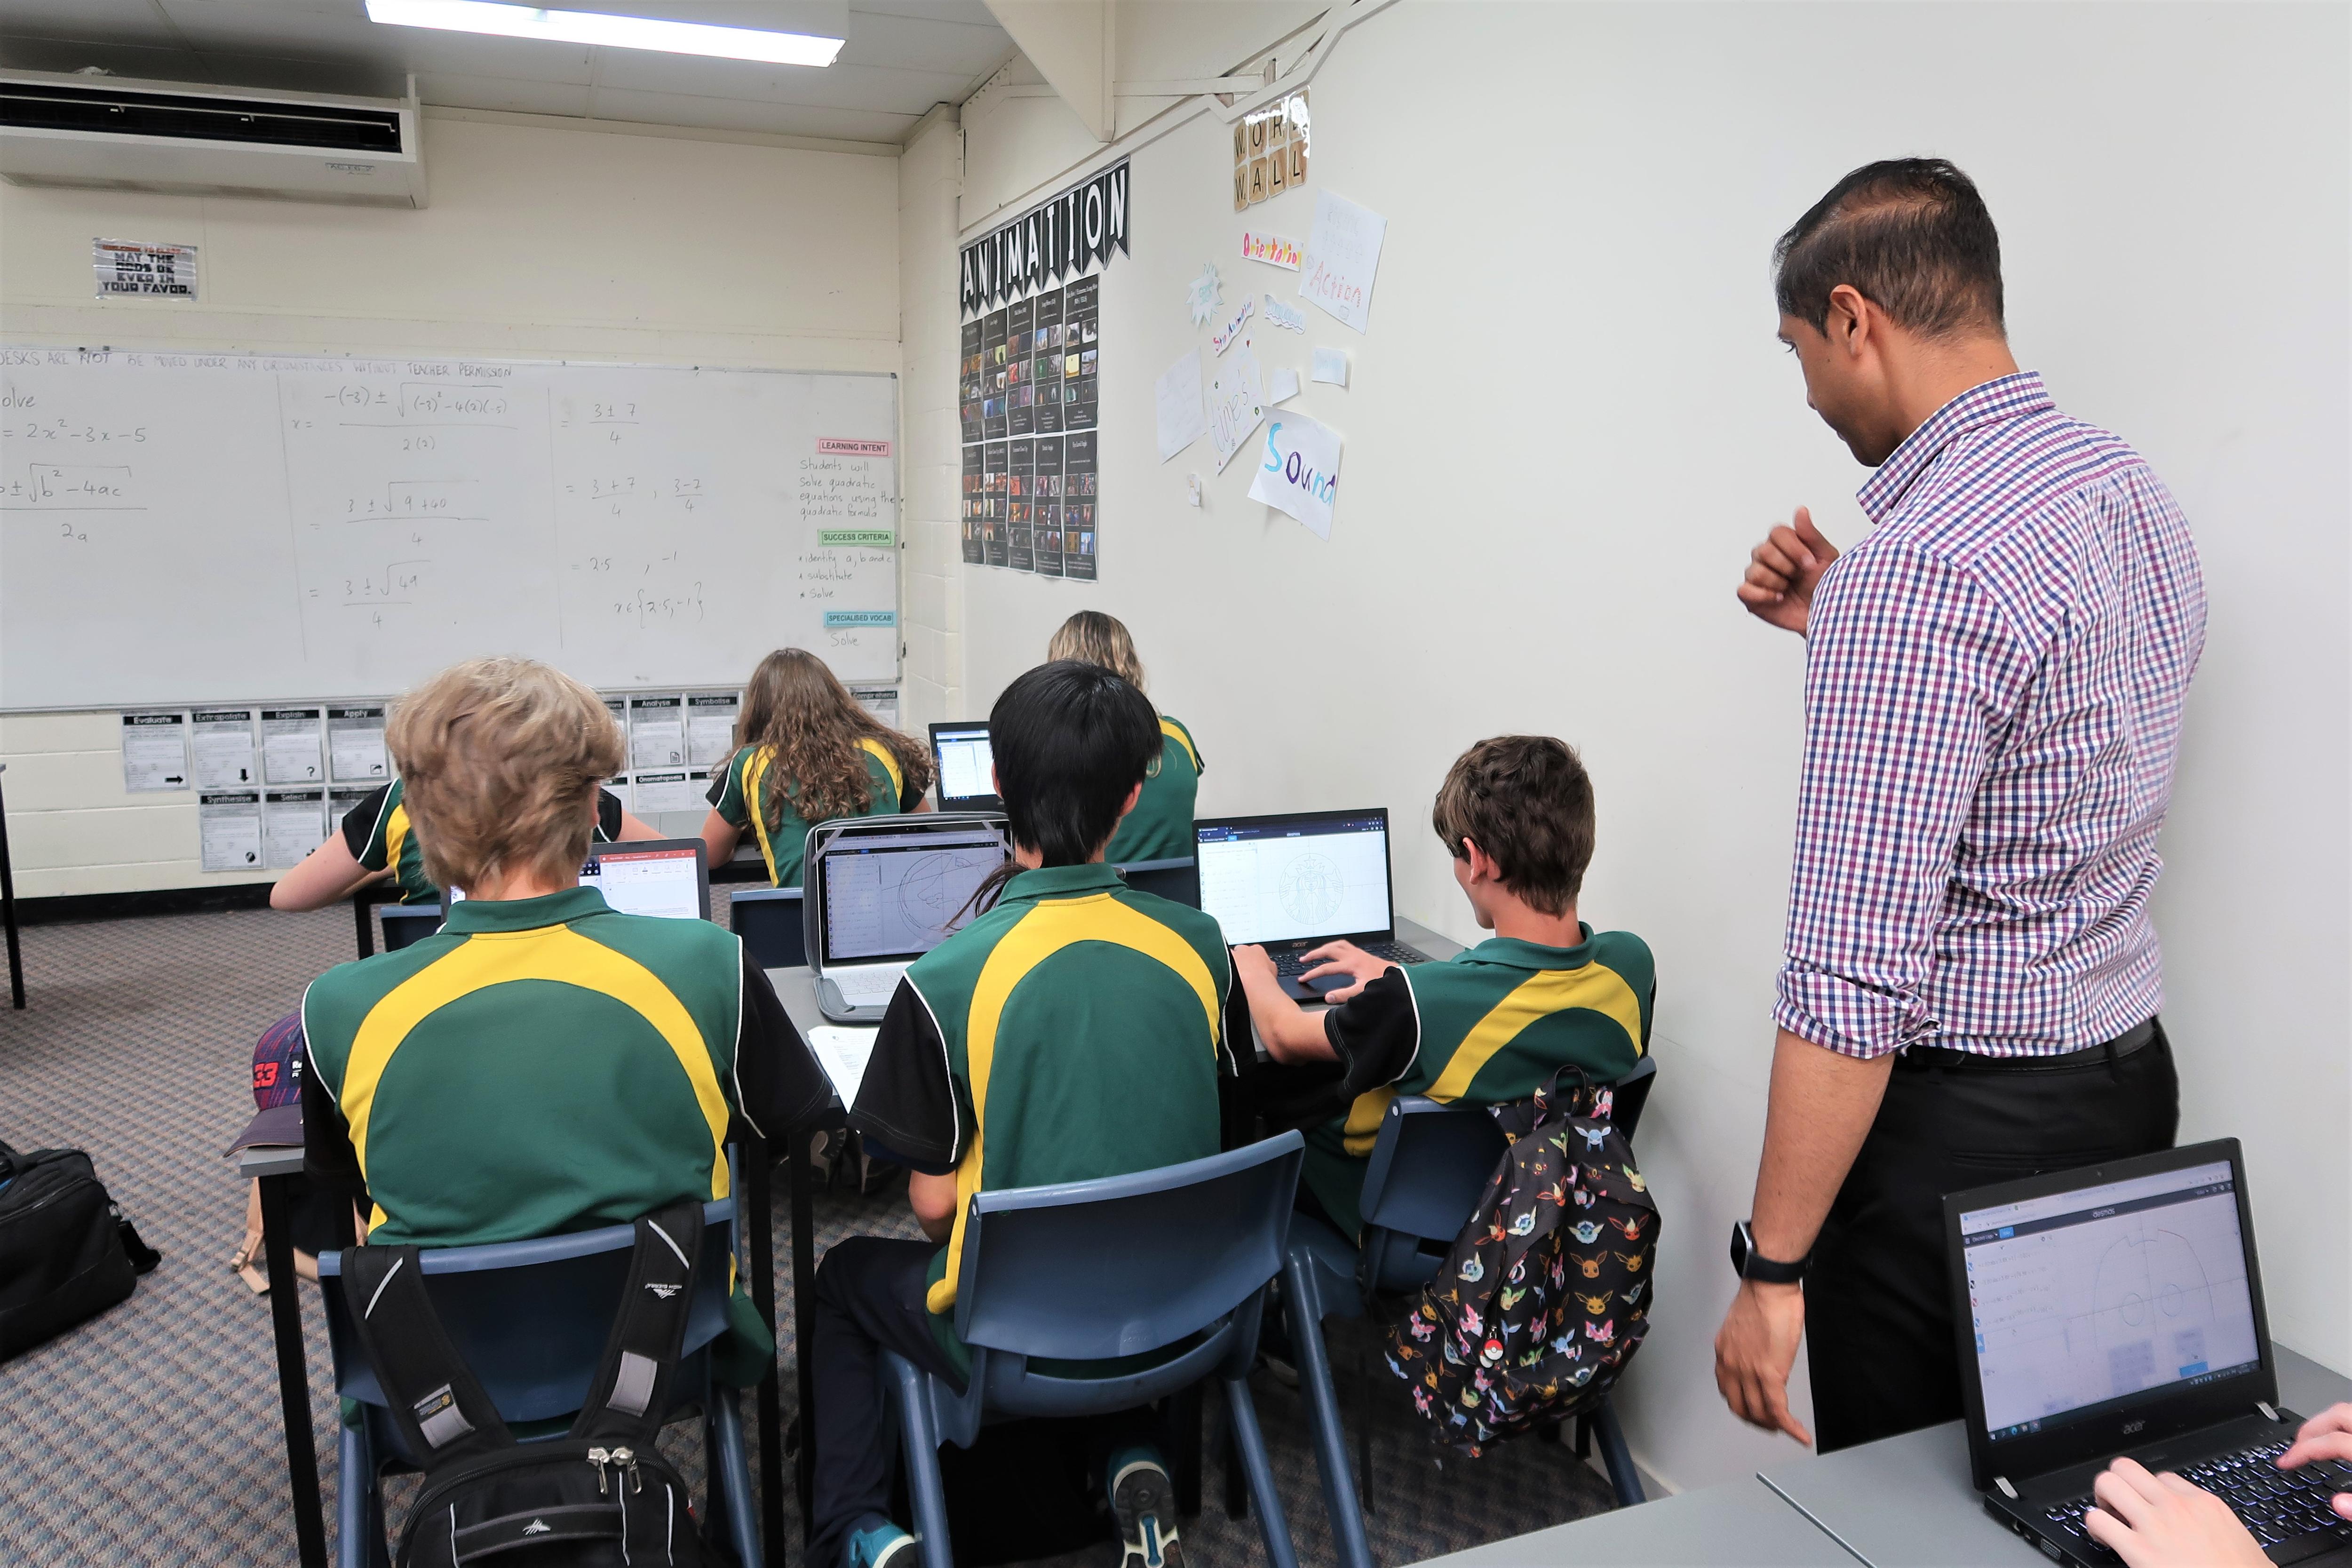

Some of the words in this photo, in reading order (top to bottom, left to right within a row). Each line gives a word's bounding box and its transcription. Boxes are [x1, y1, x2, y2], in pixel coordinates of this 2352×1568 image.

[1235, 114, 1308, 158] WOR
[1235, 150, 1301, 202] WALL
[963, 169, 1125, 302] ANIMATION
[117, 272, 153, 282] EVER
[1309, 260, 1361, 308] Action
[103, 282, 138, 292] YOUR
[143, 284, 191, 294] FAVOR.
[48, 352, 68, 365] ARE
[80, 352, 111, 364] NOT
[127, 354, 143, 366] BE
[194, 357, 227, 369] UNDER
[238, 358, 256, 370] ANY
[406, 363, 450, 376] TEACHER
[459, 364, 512, 377] PERMISSION
[822, 442, 859, 451] LEARNING
[860, 444, 886, 452] INTENT
[800, 457, 842, 471] Students
[850, 461, 869, 472] will
[1264, 422, 1336, 507] Sound
[800, 475, 823, 487] Solve
[829, 475, 875, 493] quadratic
[800, 491, 843, 505] equations
[851, 495, 876, 509] using
[881, 491, 896, 504] the
[800, 505, 843, 521] quadratic
[848, 503, 877, 518] formula
[805, 549, 837, 569] identify
[870, 553, 884, 563] and
[807, 569, 852, 581] substitute
[810, 587, 835, 599] Solve
[830, 632, 860, 647] Solve
[134, 716, 172, 724] Evaluate
[195, 712, 246, 722] Extrapolate
[343, 709, 368, 718] Apply
[207, 795, 252, 804] Synthesise
[281, 793, 308, 802] Select
[254, 1062, 278, 1088] 33
[2123, 1420, 2146, 1434] acer
